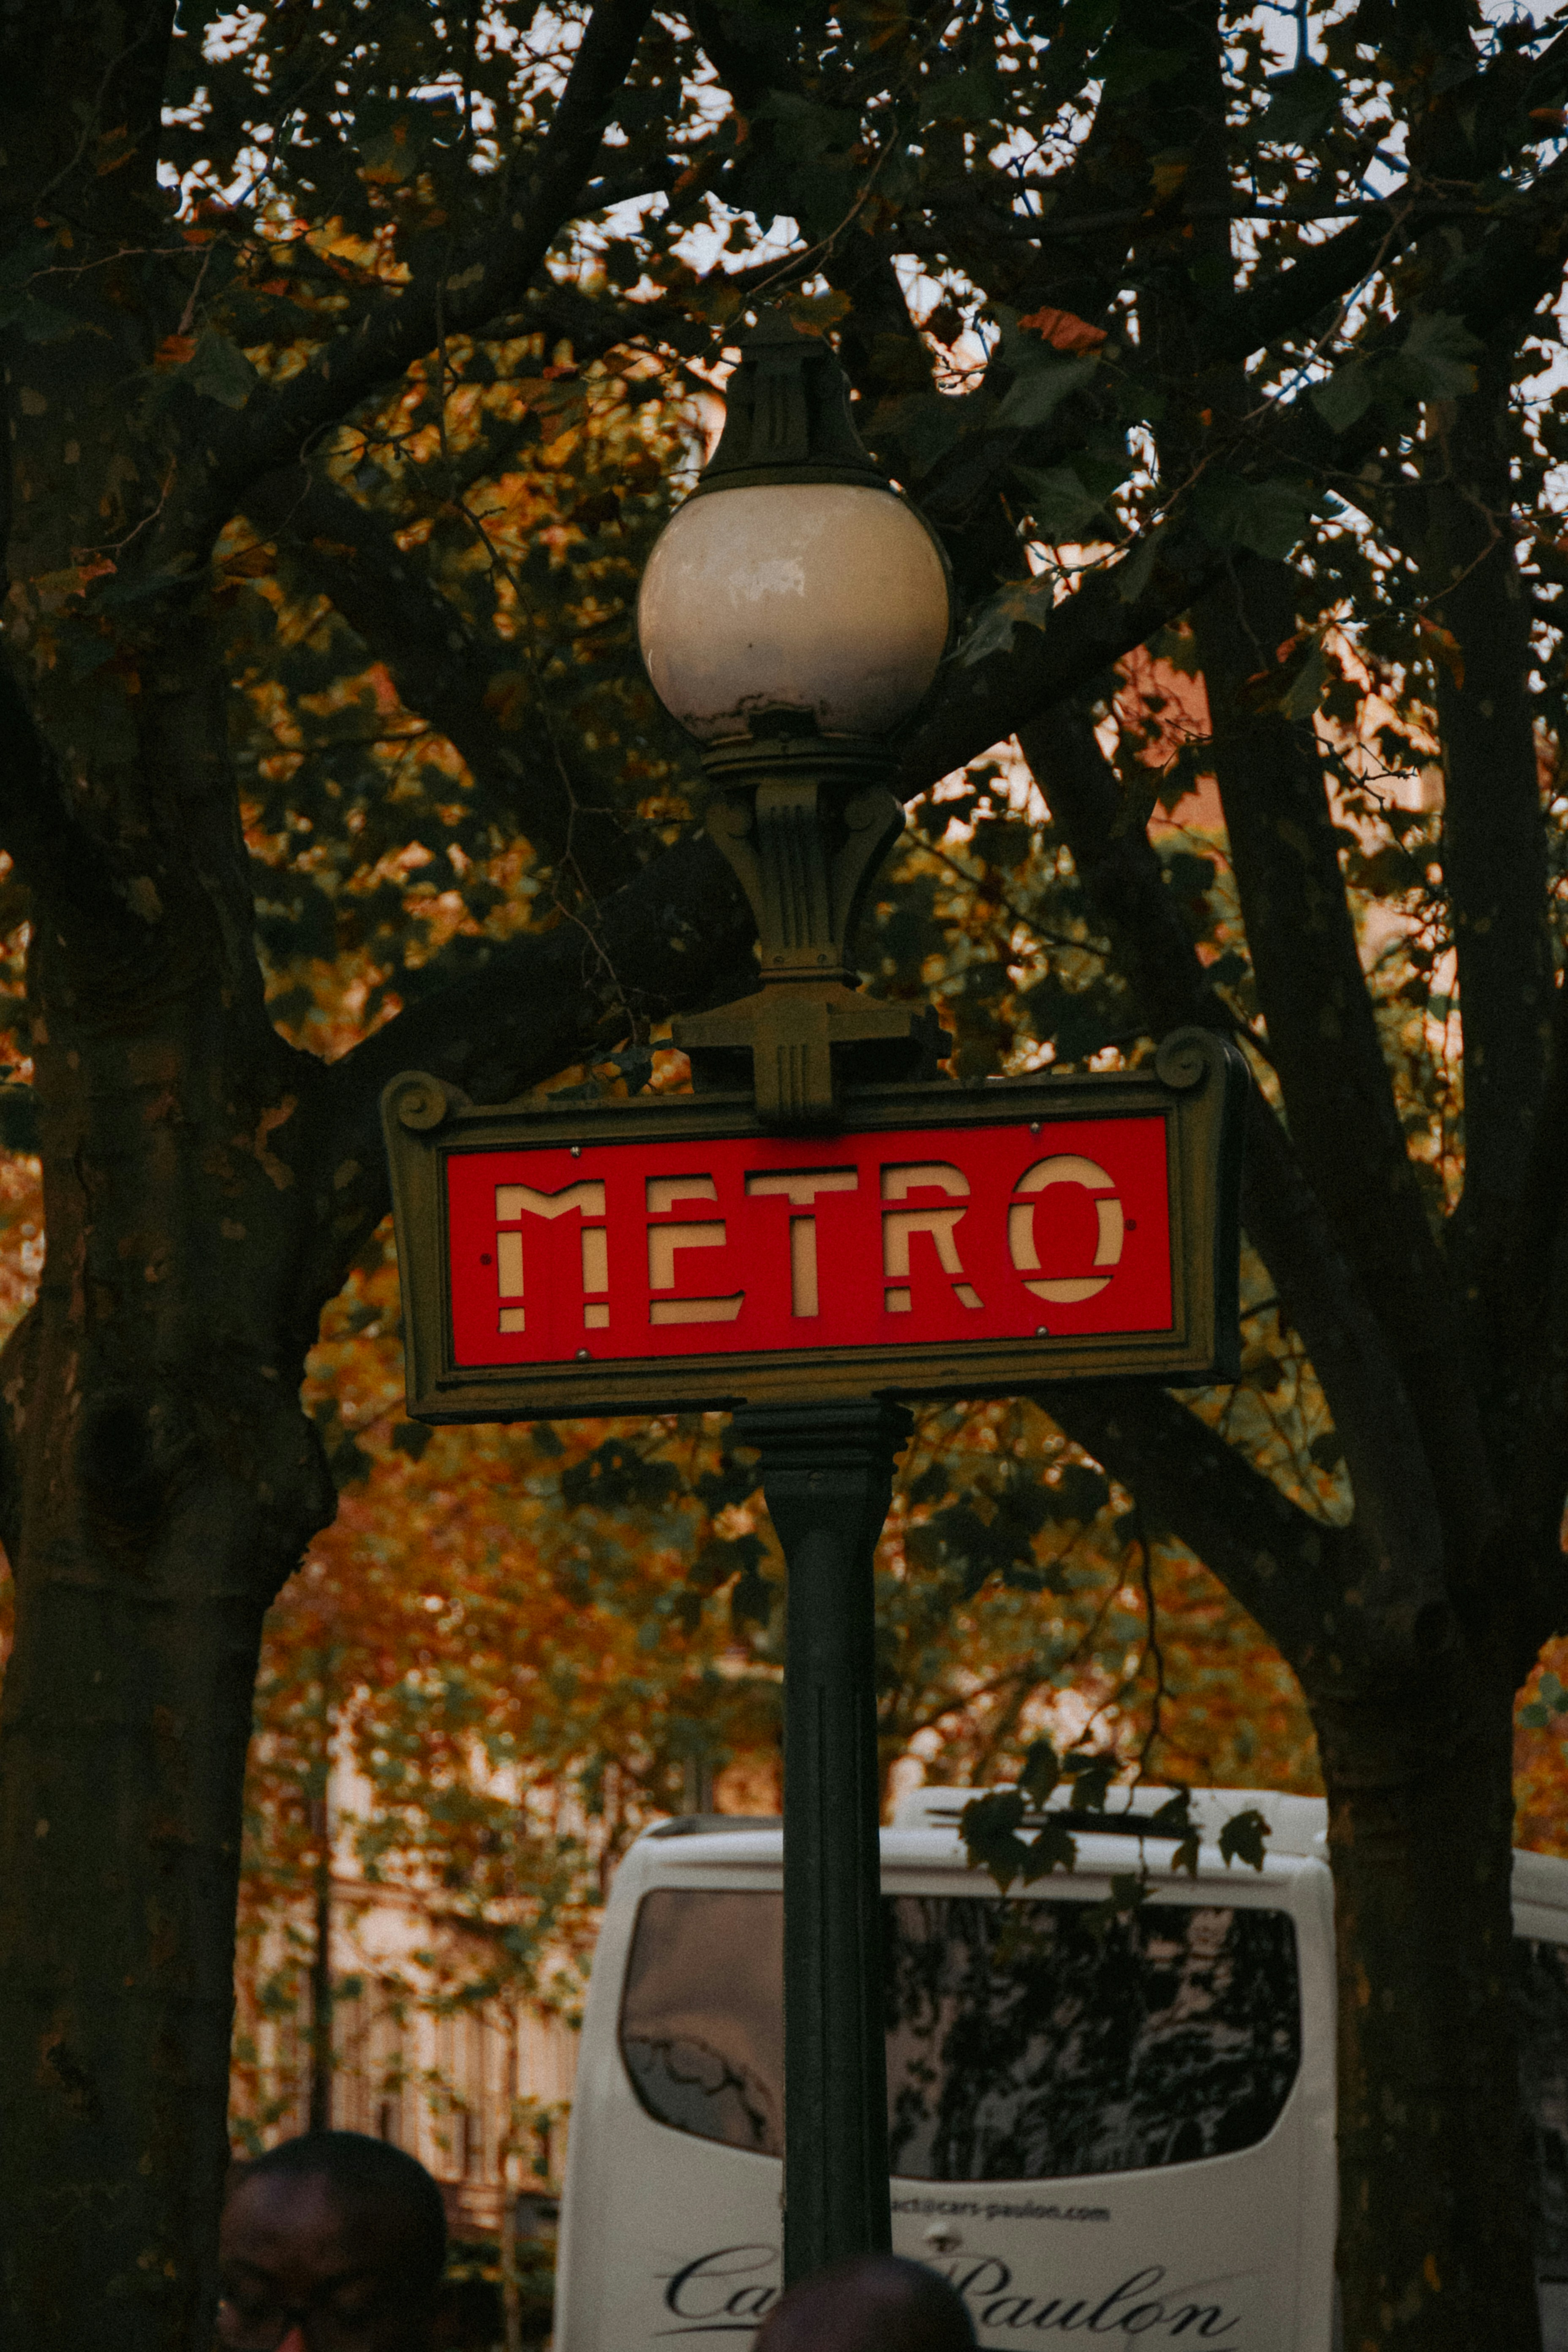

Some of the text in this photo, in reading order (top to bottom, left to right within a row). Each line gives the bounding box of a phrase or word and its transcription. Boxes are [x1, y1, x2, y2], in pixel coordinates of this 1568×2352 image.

[495, 1154, 1125, 1334] METRO
[891, 2198, 1111, 2221] act@cars-paulon.com
[654, 2243, 1241, 2337] Ca Paulon
